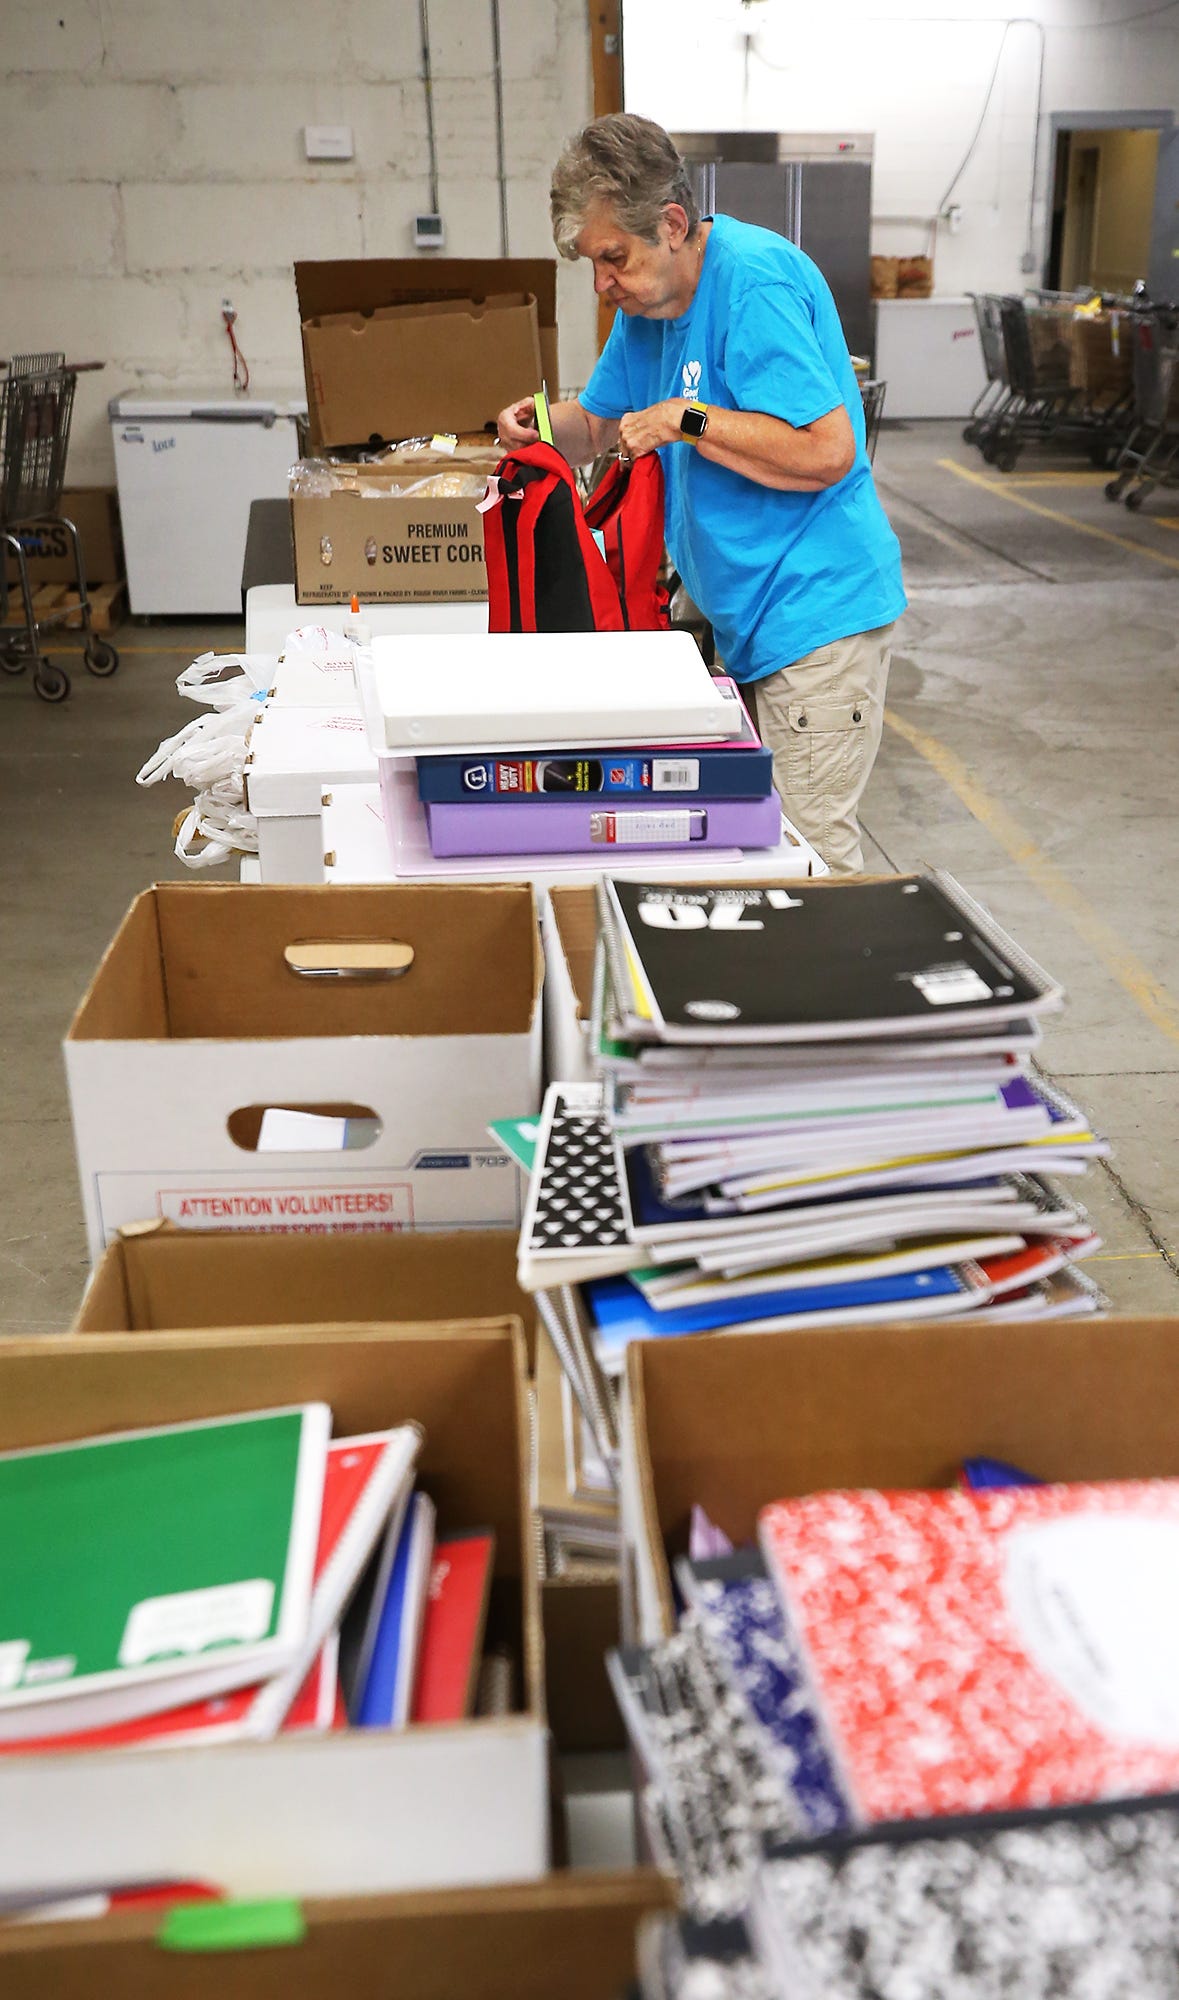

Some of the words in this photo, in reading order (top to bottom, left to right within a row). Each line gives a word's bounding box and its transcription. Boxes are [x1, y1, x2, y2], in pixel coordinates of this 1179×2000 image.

[408, 524, 468, 538] PREMIUM
[382, 545, 441, 564] SWEET
[447, 544, 485, 562] COR
[179, 1196, 272, 1217] ATTENTION
[275, 1193, 393, 1214] VOLUNTEERS!
